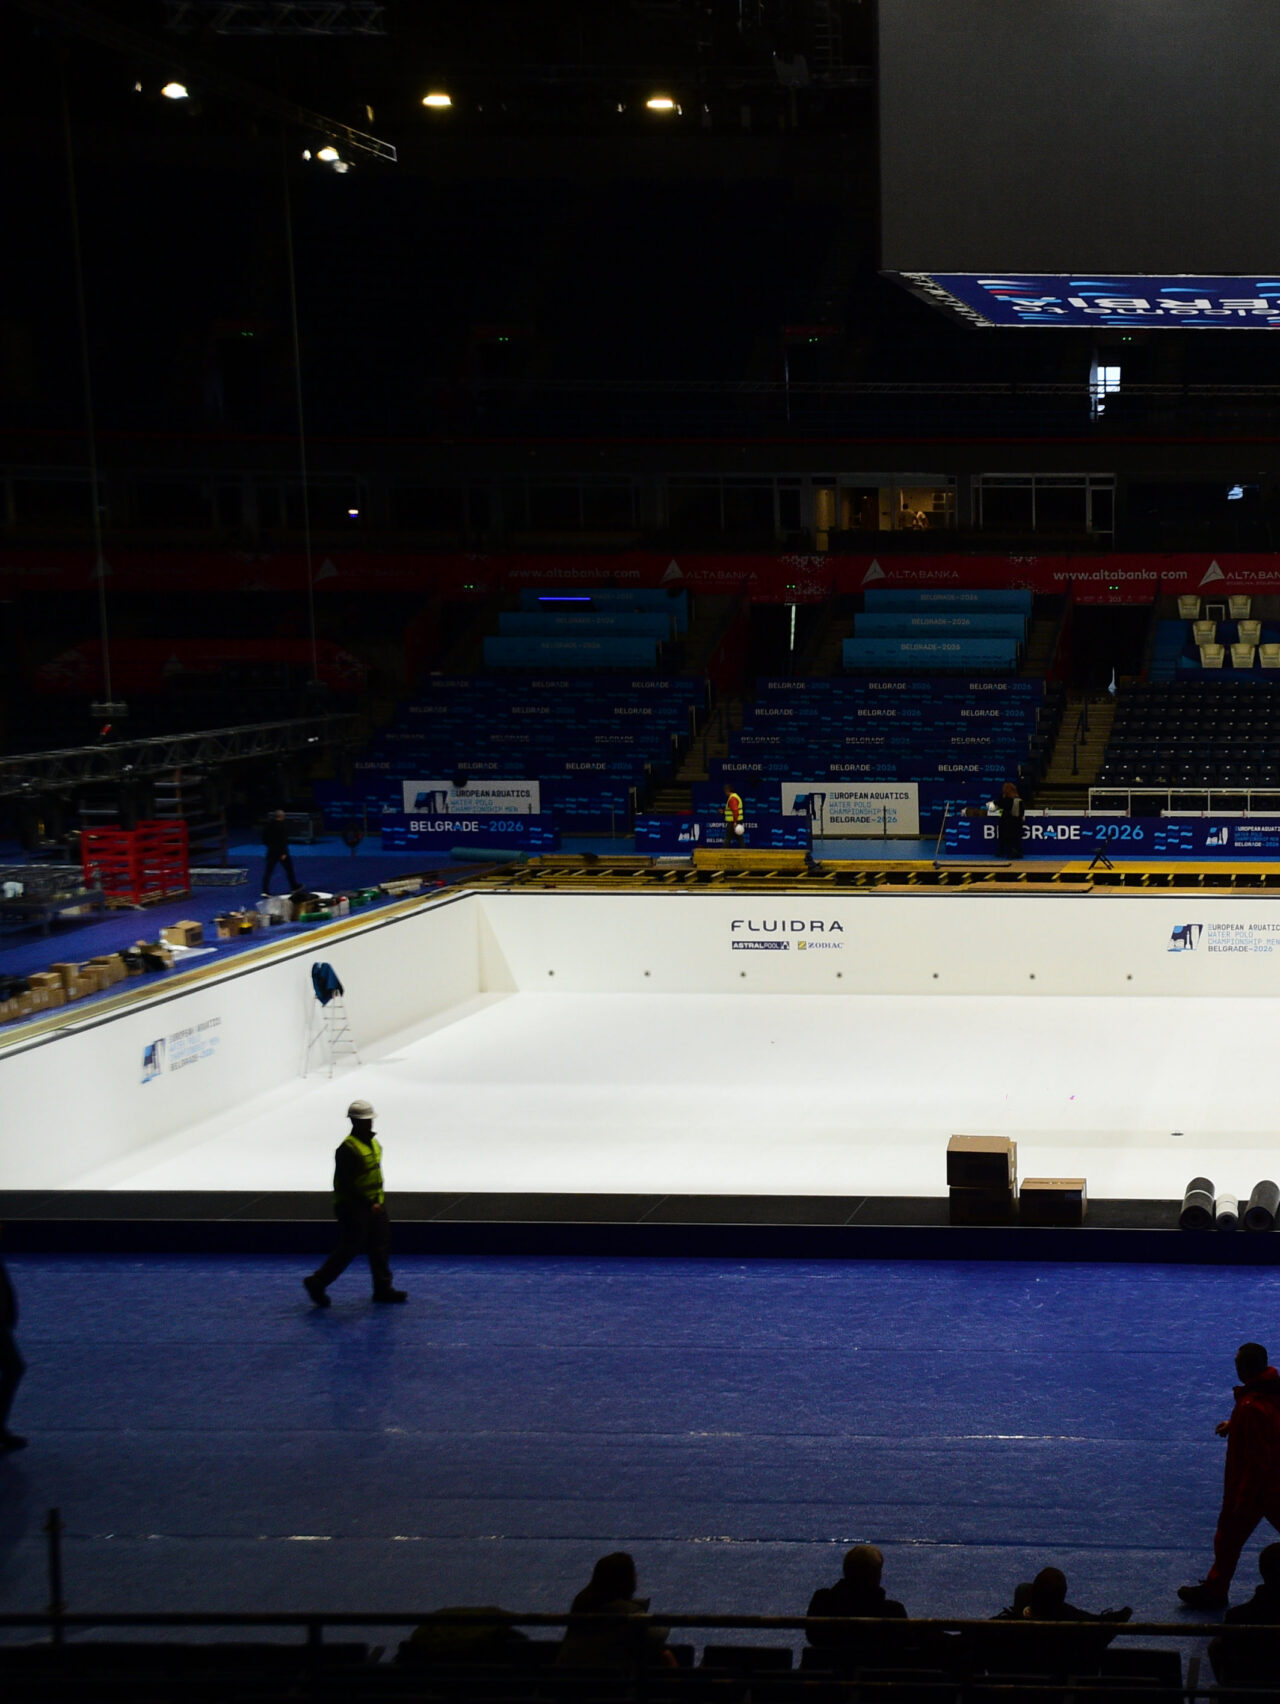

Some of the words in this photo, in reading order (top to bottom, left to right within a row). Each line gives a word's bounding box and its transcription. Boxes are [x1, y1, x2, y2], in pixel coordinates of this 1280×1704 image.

[1012, 305, 1068, 315] to
[1053, 568, 1187, 580] www.altabankacom
[731, 920, 844, 932] FLUIDRA
